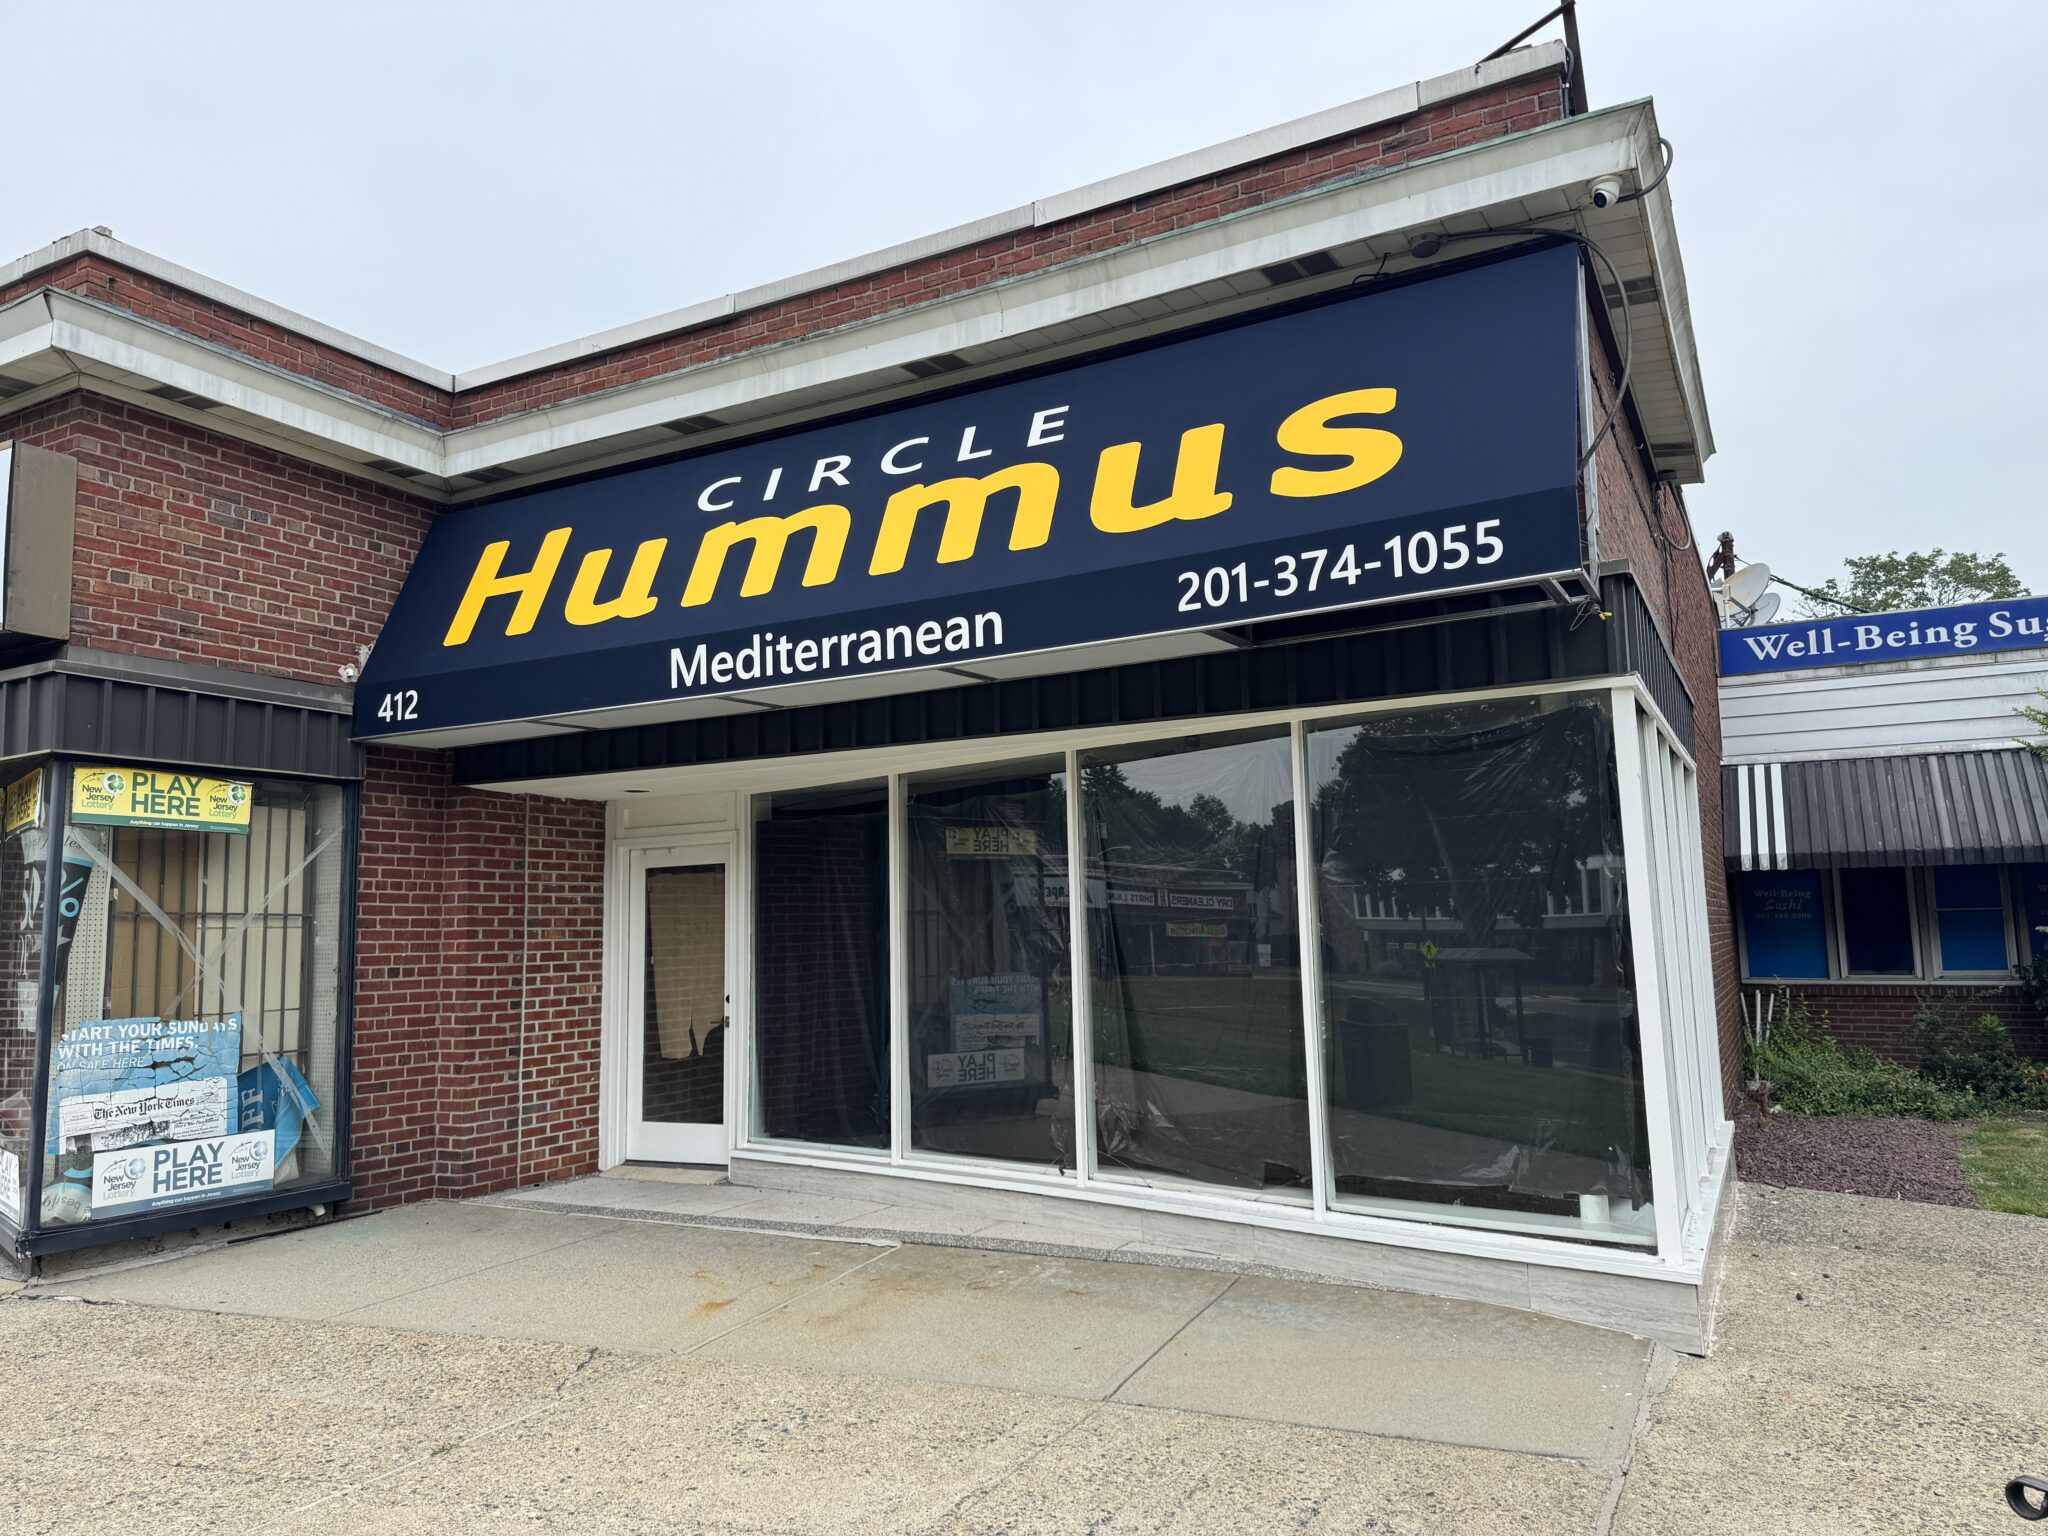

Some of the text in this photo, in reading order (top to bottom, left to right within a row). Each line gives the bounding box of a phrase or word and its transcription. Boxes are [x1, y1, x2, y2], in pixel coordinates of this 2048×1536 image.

[697, 405, 1069, 512] CIRCLE
[444, 387, 1403, 647] Hummus
[1178, 518, 1505, 613] 201-374-1055
[1742, 611, 2048, 661] Well-Being Su
[669, 611, 1003, 690] Mediterranean
[377, 690, 418, 723] 412
[82, 784, 103, 793] New
[132, 772, 204, 796] PLAY
[81, 799, 114, 810] Lottery
[86, 792, 114, 803] Jersey
[131, 793, 200, 816] HERE
[209, 795, 228, 805] New
[209, 809, 237, 819] Lottery
[213, 802, 238, 813] Jersey
[118, 1023, 164, 1039] YOUR
[58, 1041, 103, 1059] WITH
[109, 1039, 141, 1054] THE
[93, 1107, 114, 1120] The
[115, 1105, 138, 1118] New
[139, 1099, 164, 1115] York
[165, 1097, 196, 1109] Times
[153, 1141, 225, 1171] PLAY
[231, 1155, 250, 1164] New
[231, 1167, 260, 1180] Lottery
[234, 1161, 261, 1171] Jersey
[103, 1174, 125, 1185] New
[107, 1181, 137, 1192] Jersey
[152, 1163, 223, 1194] HERE
[103, 1188, 136, 1200] Lottery
